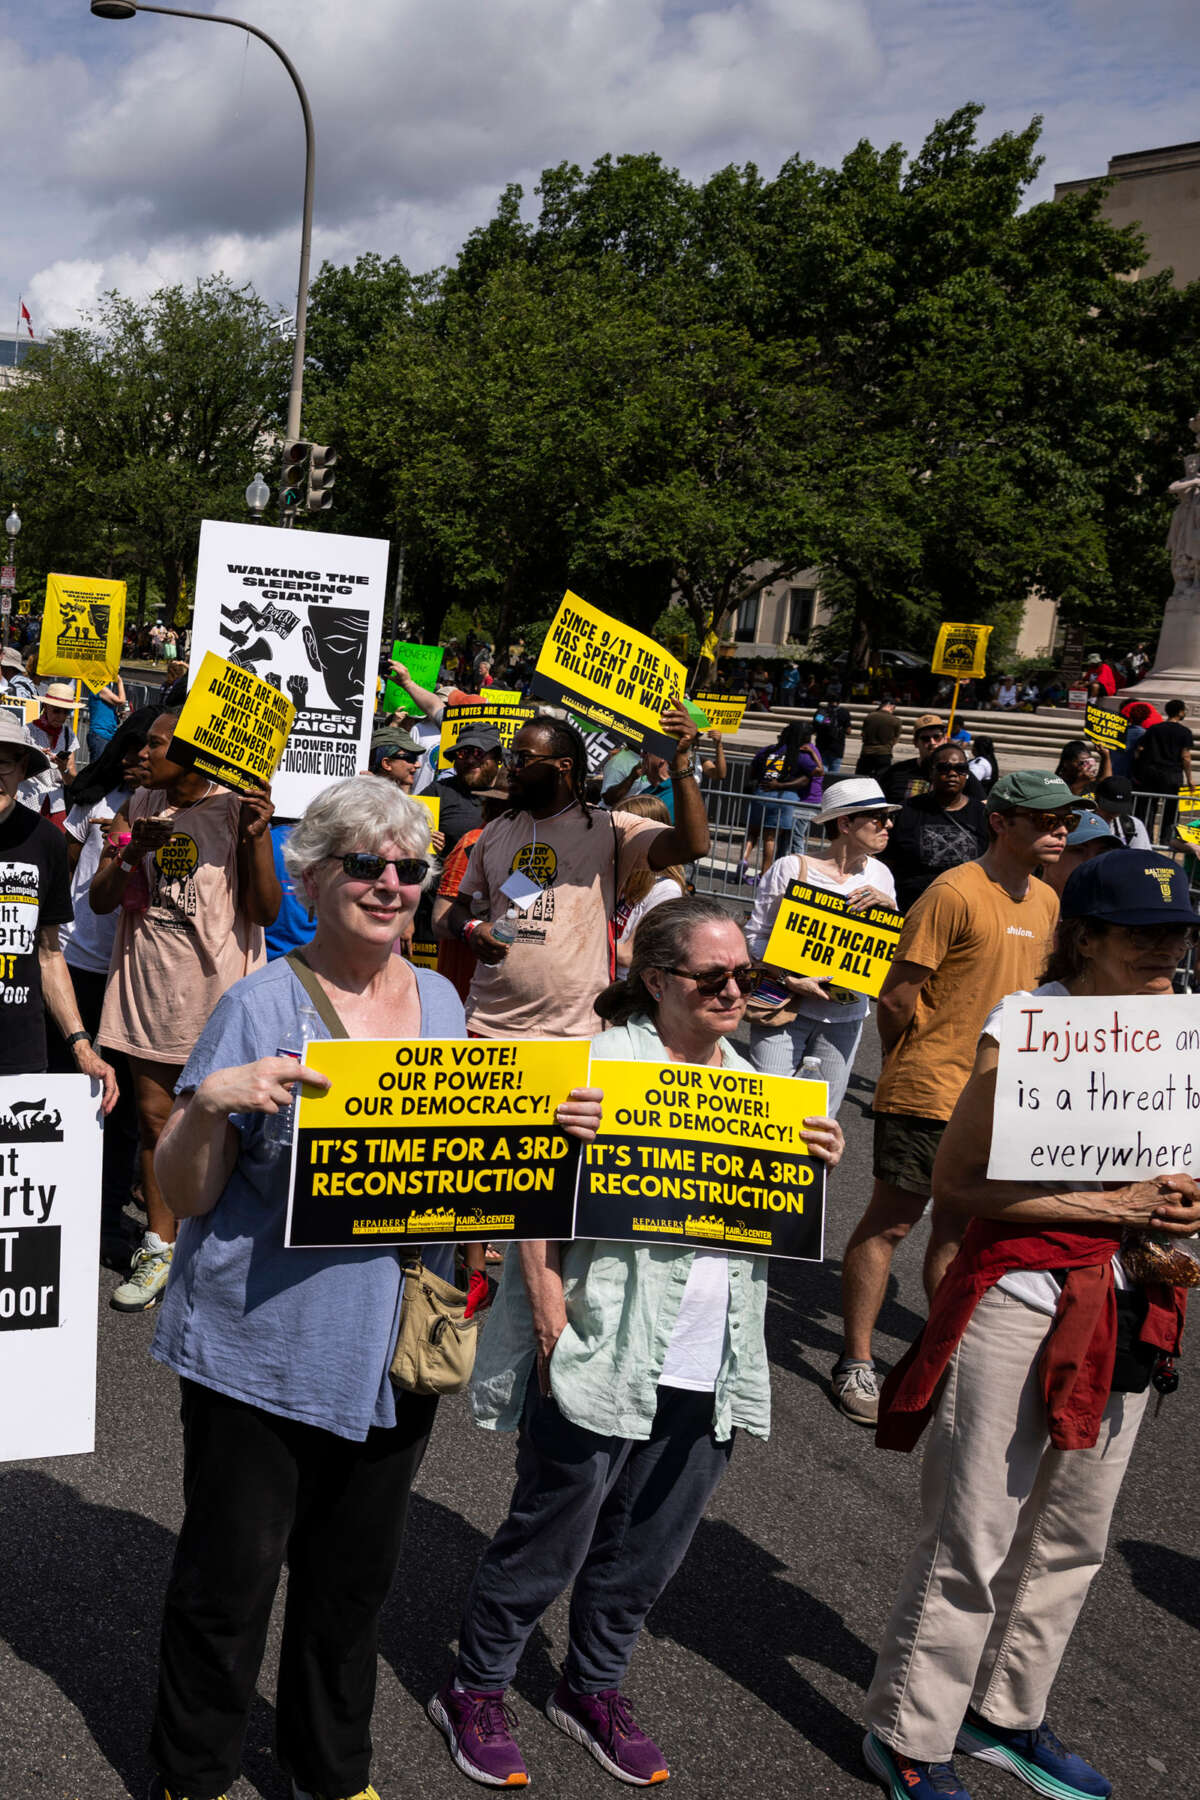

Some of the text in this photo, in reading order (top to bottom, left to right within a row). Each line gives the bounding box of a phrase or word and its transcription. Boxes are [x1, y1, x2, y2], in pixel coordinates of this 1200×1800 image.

[227, 564, 370, 585] WAKING THE
[242, 577, 353, 596] SLEEPING
[261, 590, 333, 604] GIANT
[266, 605, 299, 628] POVERTY
[398, 646, 439, 661] POVERTY
[552, 625, 665, 694] HAS SPENT OVER
[560, 608, 680, 692] SINCE 9/11 THE U.S.
[223, 666, 289, 718] THERE ARE MORE
[554, 646, 672, 714] TRILLION ON WAR
[208, 678, 261, 718] AVAILABLE
[221, 703, 274, 741] UNITS THAN
[447, 707, 535, 718] OUR VOTES ARE DEMANDS
[1087, 705, 1128, 727] EVERYBODY'S
[1087, 714, 1127, 733] GOT A RIGHT
[193, 726, 245, 762] UNHOUSED
[208, 714, 276, 762] THE NUMBER OF
[1093, 725, 1119, 738] TO LIVE
[295, 738, 357, 754] POWER FOR
[324, 753, 357, 777] VOTERS
[163, 848, 191, 857] BODY
[518, 856, 549, 865] BODY
[5, 885, 38, 897] Campaign
[792, 885, 813, 901] OUR
[814, 892, 845, 911] VOTES
[785, 911, 897, 962] HEALTHCARE
[800, 939, 871, 978] FOR ALL
[1017, 1008, 1162, 1063] Injustice
[395, 1046, 518, 1067] OUR VOTE!
[378, 1070, 523, 1091] OUR POWER!
[659, 1068, 763, 1097] OUR VOTE!
[1017, 1071, 1200, 1111] is a threat to
[344, 1094, 551, 1116] OUR DEMOCRACY!
[645, 1089, 770, 1118] OUR POWER!
[615, 1108, 794, 1144] OUR DEMOCRACY!
[310, 1136, 569, 1165] IT'S TIME FOR A 3RD
[1030, 1131, 1193, 1176] everywhere
[585, 1144, 815, 1187] IT'S TIME FOR A 3RD
[312, 1167, 556, 1197] RECONSTRUCTION
[589, 1172, 804, 1215] RECONSTRUCTION
[353, 1219, 406, 1227] REPAIRERS
[486, 1214, 515, 1224] CENTER
[632, 1217, 684, 1228] REPAIRERS
[748, 1228, 772, 1240] CENTER
